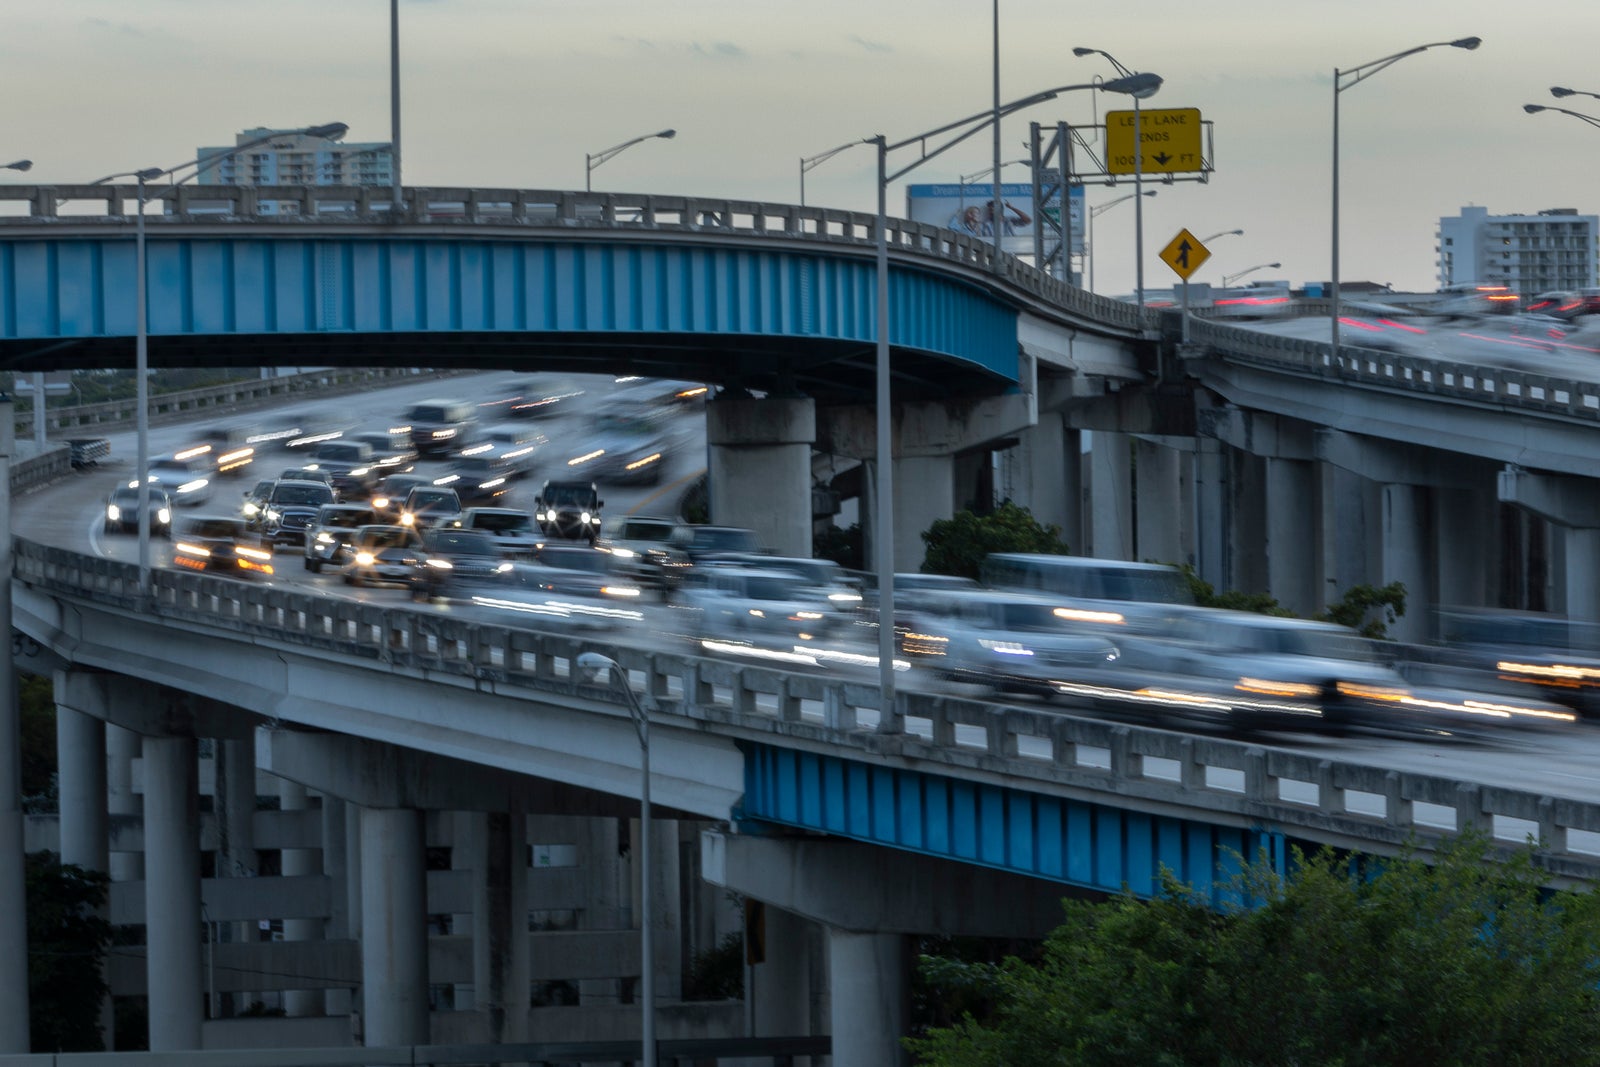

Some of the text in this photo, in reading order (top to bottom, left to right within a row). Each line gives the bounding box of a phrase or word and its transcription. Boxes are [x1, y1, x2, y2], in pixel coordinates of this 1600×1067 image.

[1154, 114, 1187, 125] LANE
[1138, 131, 1170, 143] ENDS
[1179, 153, 1194, 164] FT
